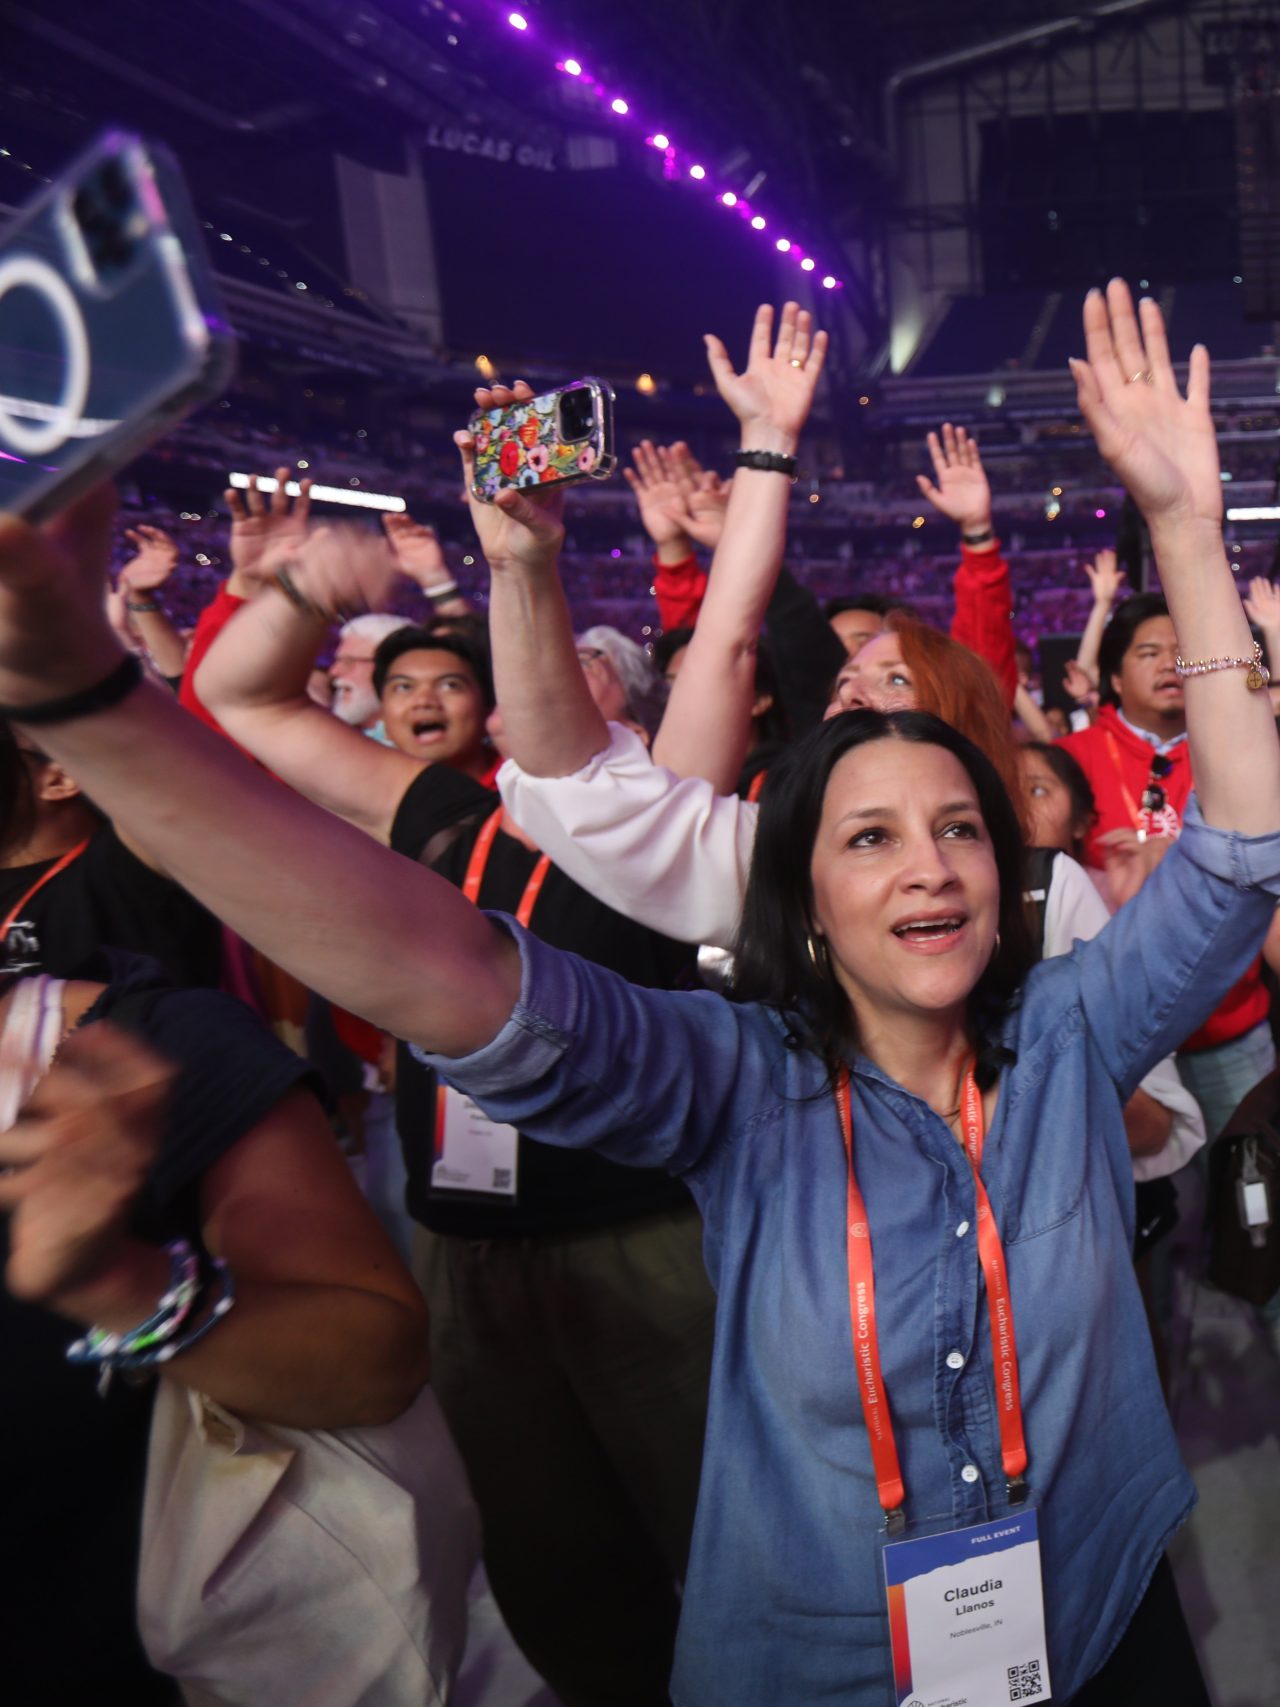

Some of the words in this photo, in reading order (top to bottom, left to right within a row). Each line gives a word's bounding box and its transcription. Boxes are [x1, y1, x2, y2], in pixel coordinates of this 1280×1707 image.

[427, 124, 513, 163] LUCAS
[515, 144, 556, 172] OIL
[856, 1281, 870, 1339] Congress
[996, 1298, 1012, 1359] Eucharistic
[859, 1342, 878, 1404] Eucharistic
[1002, 1361, 1015, 1411] Congress
[971, 1534, 992, 1544] FULL
[993, 1526, 1021, 1539] EVENT
[944, 1578, 1003, 1602] Claudia
[955, 1600, 995, 1616] Llanos
